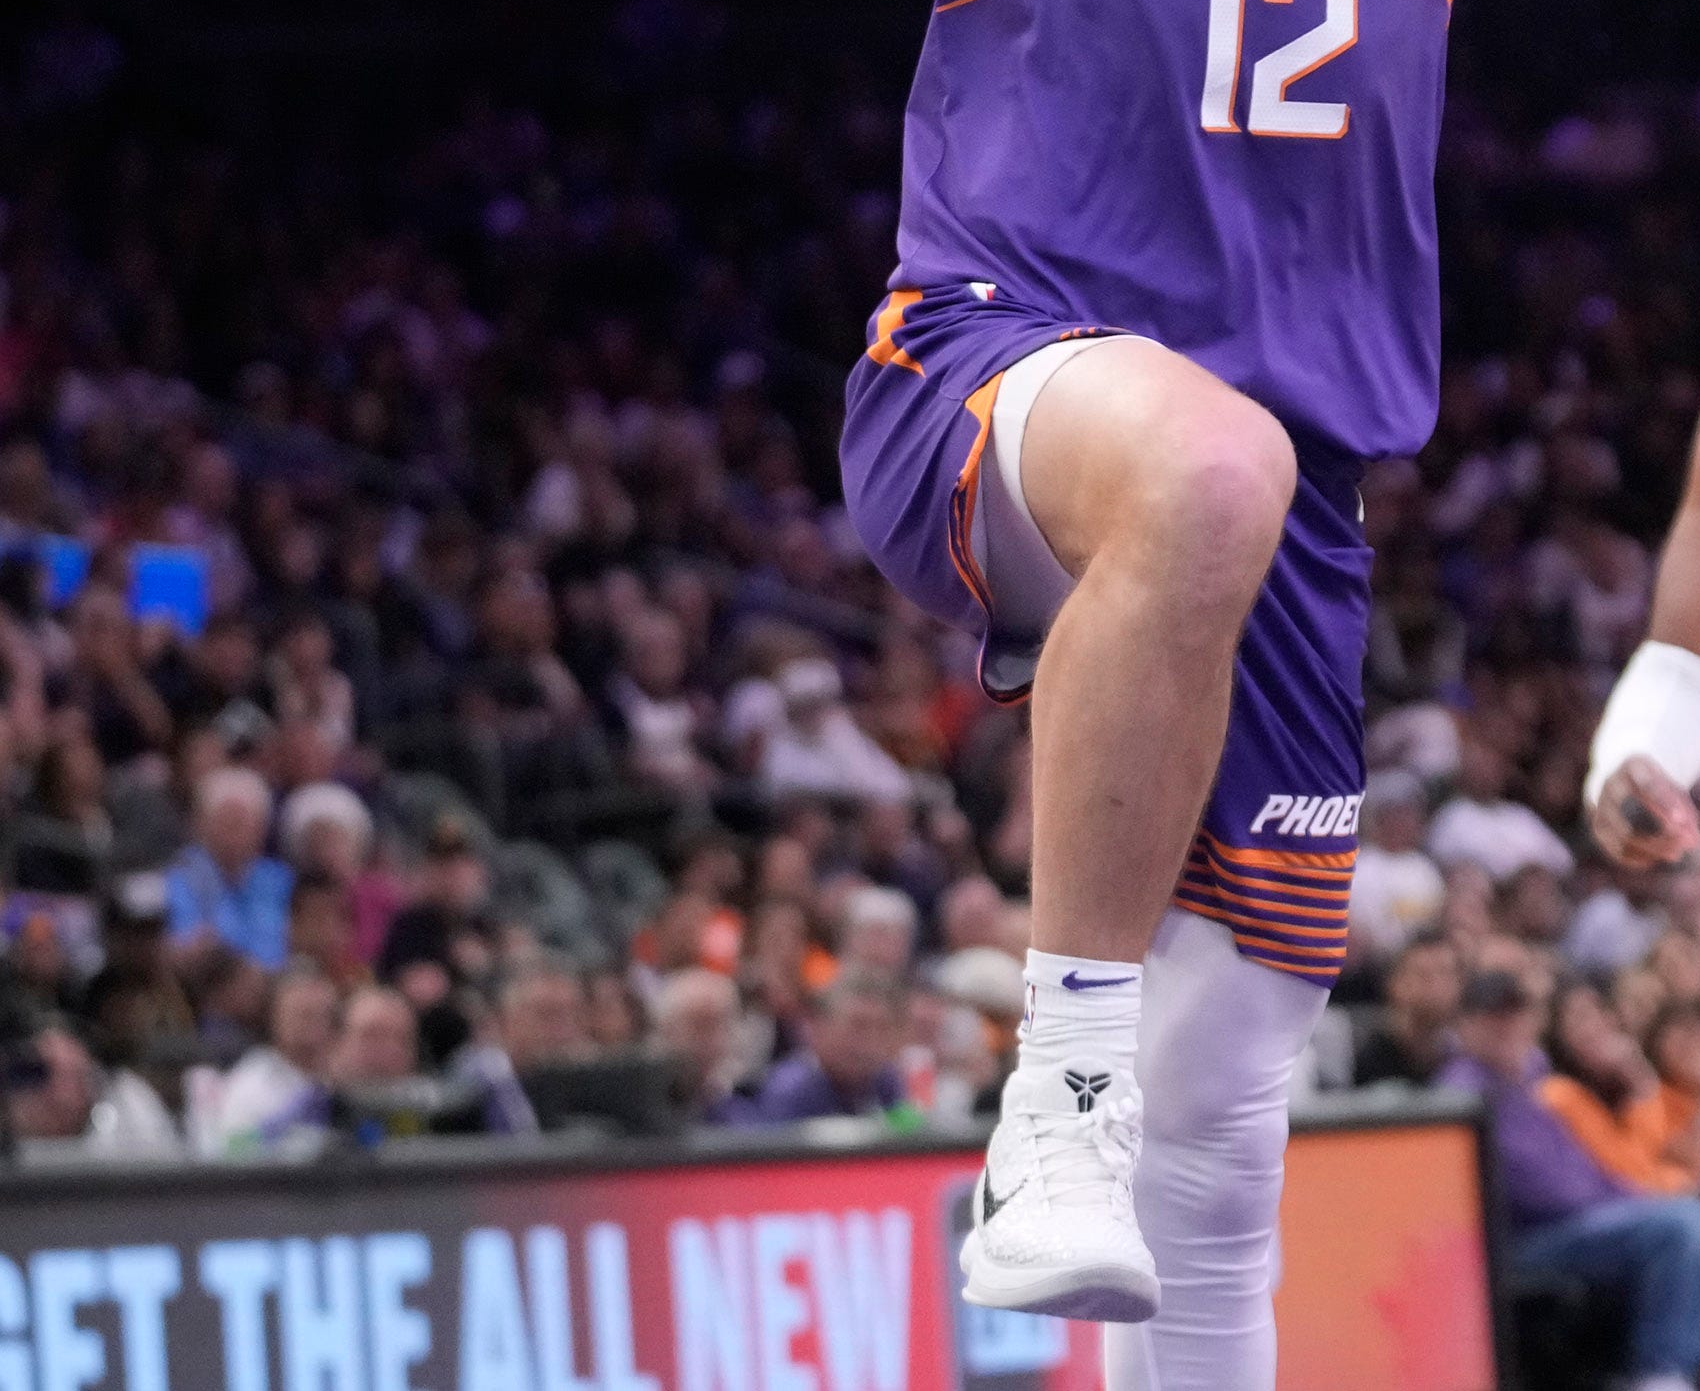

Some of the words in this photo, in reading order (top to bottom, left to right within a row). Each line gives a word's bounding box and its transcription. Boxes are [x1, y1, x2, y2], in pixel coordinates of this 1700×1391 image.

[199, 1230, 432, 1391] THE
[459, 1222, 664, 1391] ALL
[669, 1206, 912, 1391] NEW
